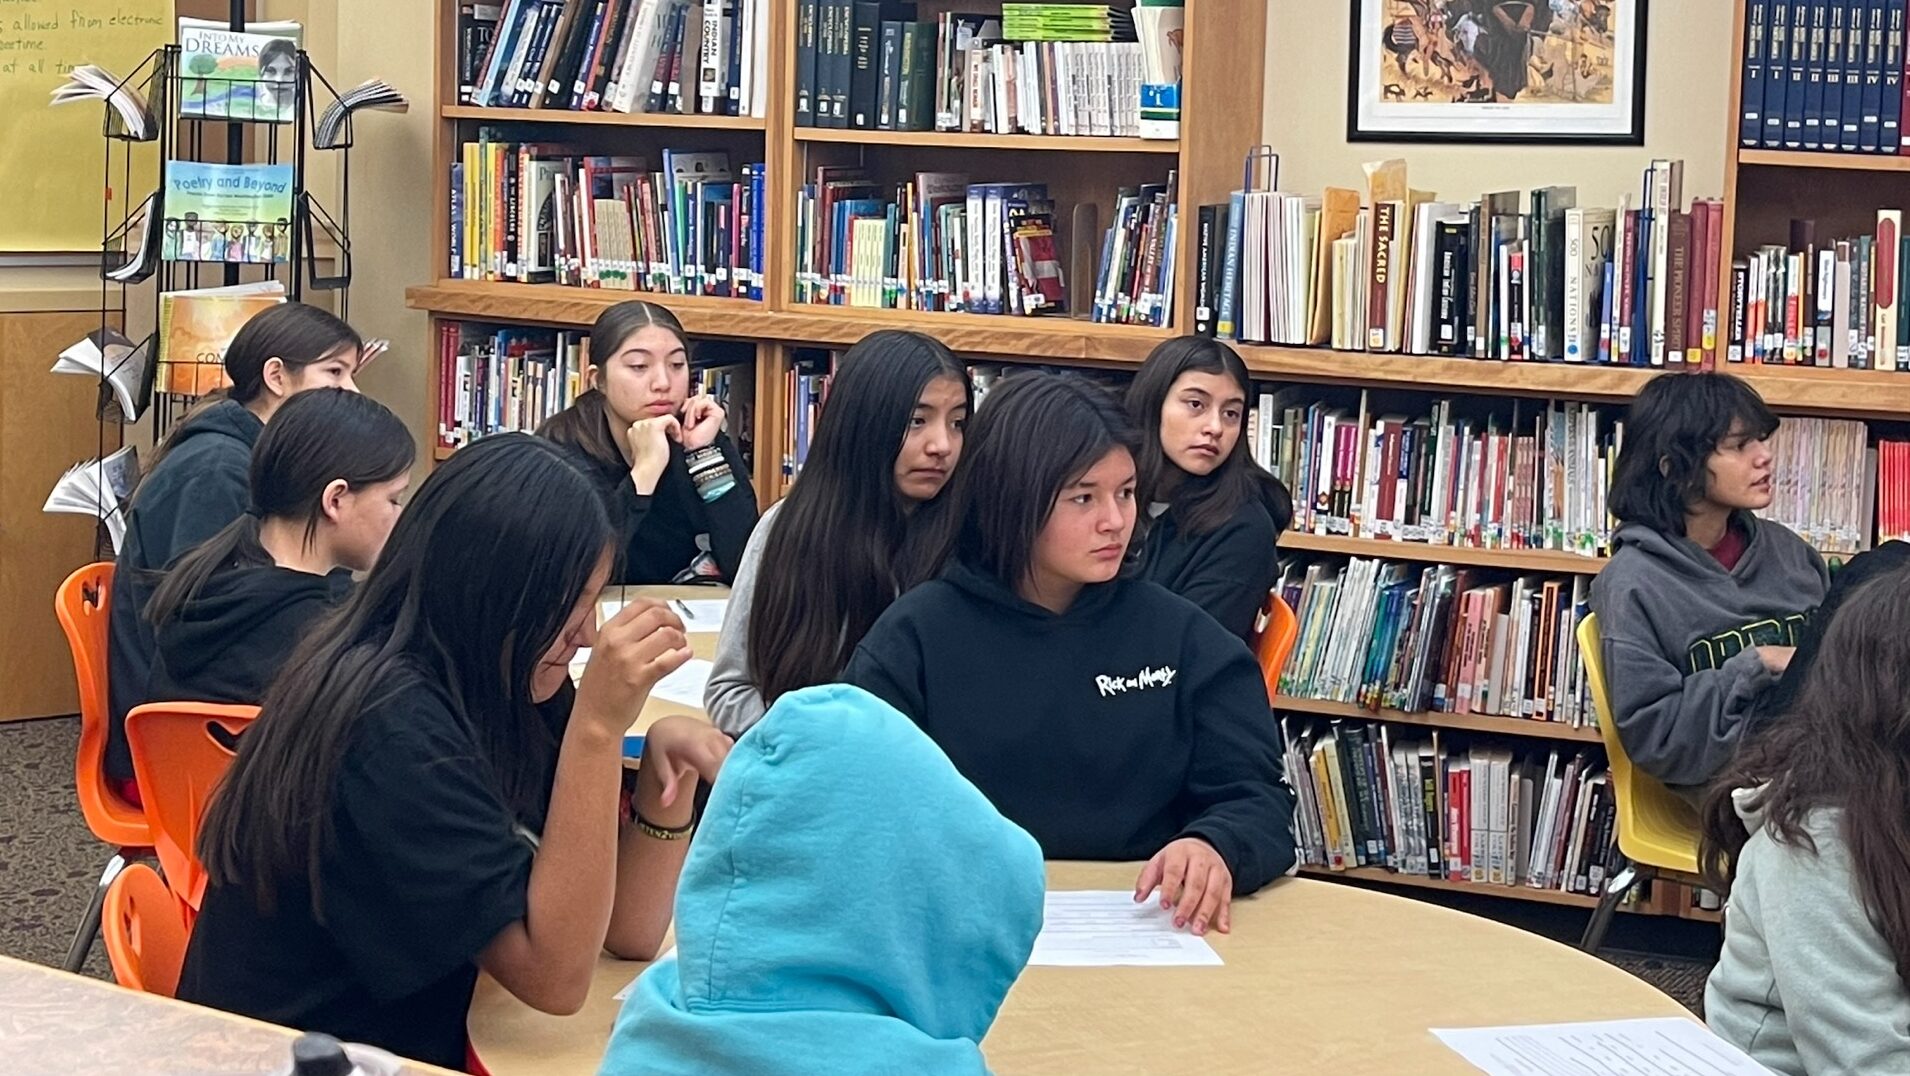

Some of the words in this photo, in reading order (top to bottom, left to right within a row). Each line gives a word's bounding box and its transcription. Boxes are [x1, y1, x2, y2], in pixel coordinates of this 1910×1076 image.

[12, 11, 59, 31] allowed
[199, 31, 225, 41] INTO
[228, 33, 245, 43] MY
[185, 37, 260, 57] DREAMS
[1792, 72, 1801, 81] II
[1811, 73, 1820, 82] II
[1827, 73, 1839, 83] III
[1847, 75, 1859, 84] III
[1866, 75, 1879, 84] IV
[1886, 76, 1899, 85] IV
[173, 176, 212, 191] Poetry
[217, 176, 240, 189] and
[243, 176, 287, 193] Beyond
[1378, 207, 1390, 227] THE
[1226, 229, 1237, 263] INDIAN
[1570, 238, 1578, 257] 500
[1376, 234, 1389, 284] SACRED
[1568, 276, 1578, 334] NATIONS
[1734, 271, 1745, 341] STORYTELLER
[1095, 674, 1127, 697] Rick
[1138, 665, 1177, 690] Morty
